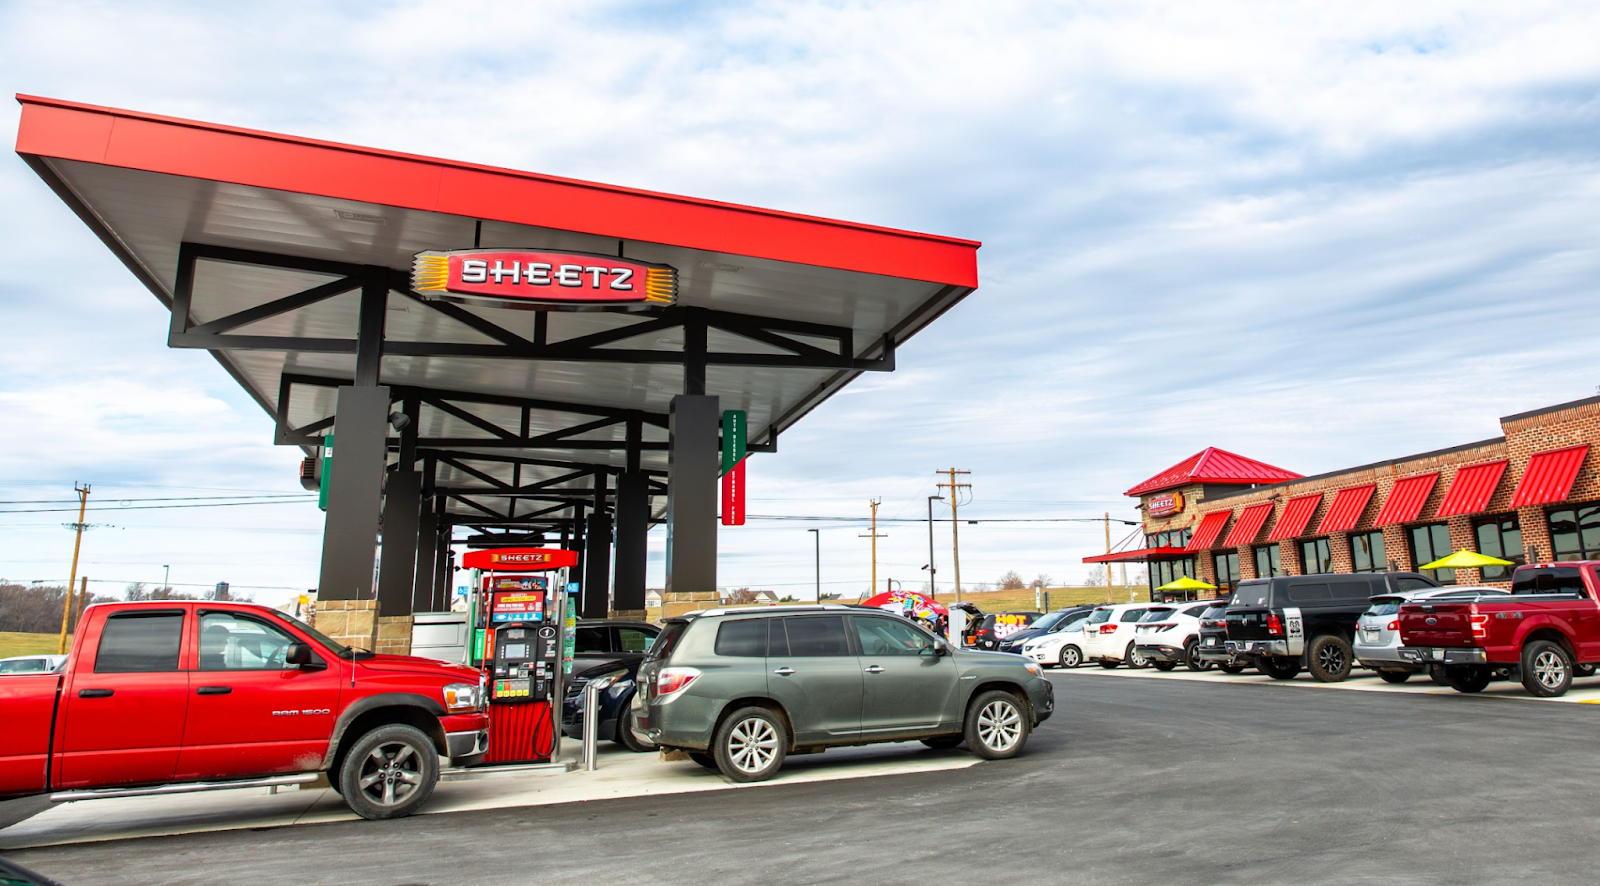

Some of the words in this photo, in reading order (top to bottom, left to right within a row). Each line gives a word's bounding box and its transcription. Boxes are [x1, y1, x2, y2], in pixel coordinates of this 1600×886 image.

[462, 259, 634, 290] SHEETZ
[1149, 499, 1173, 509] SHEETZ
[994, 614, 1027, 625] HOT
